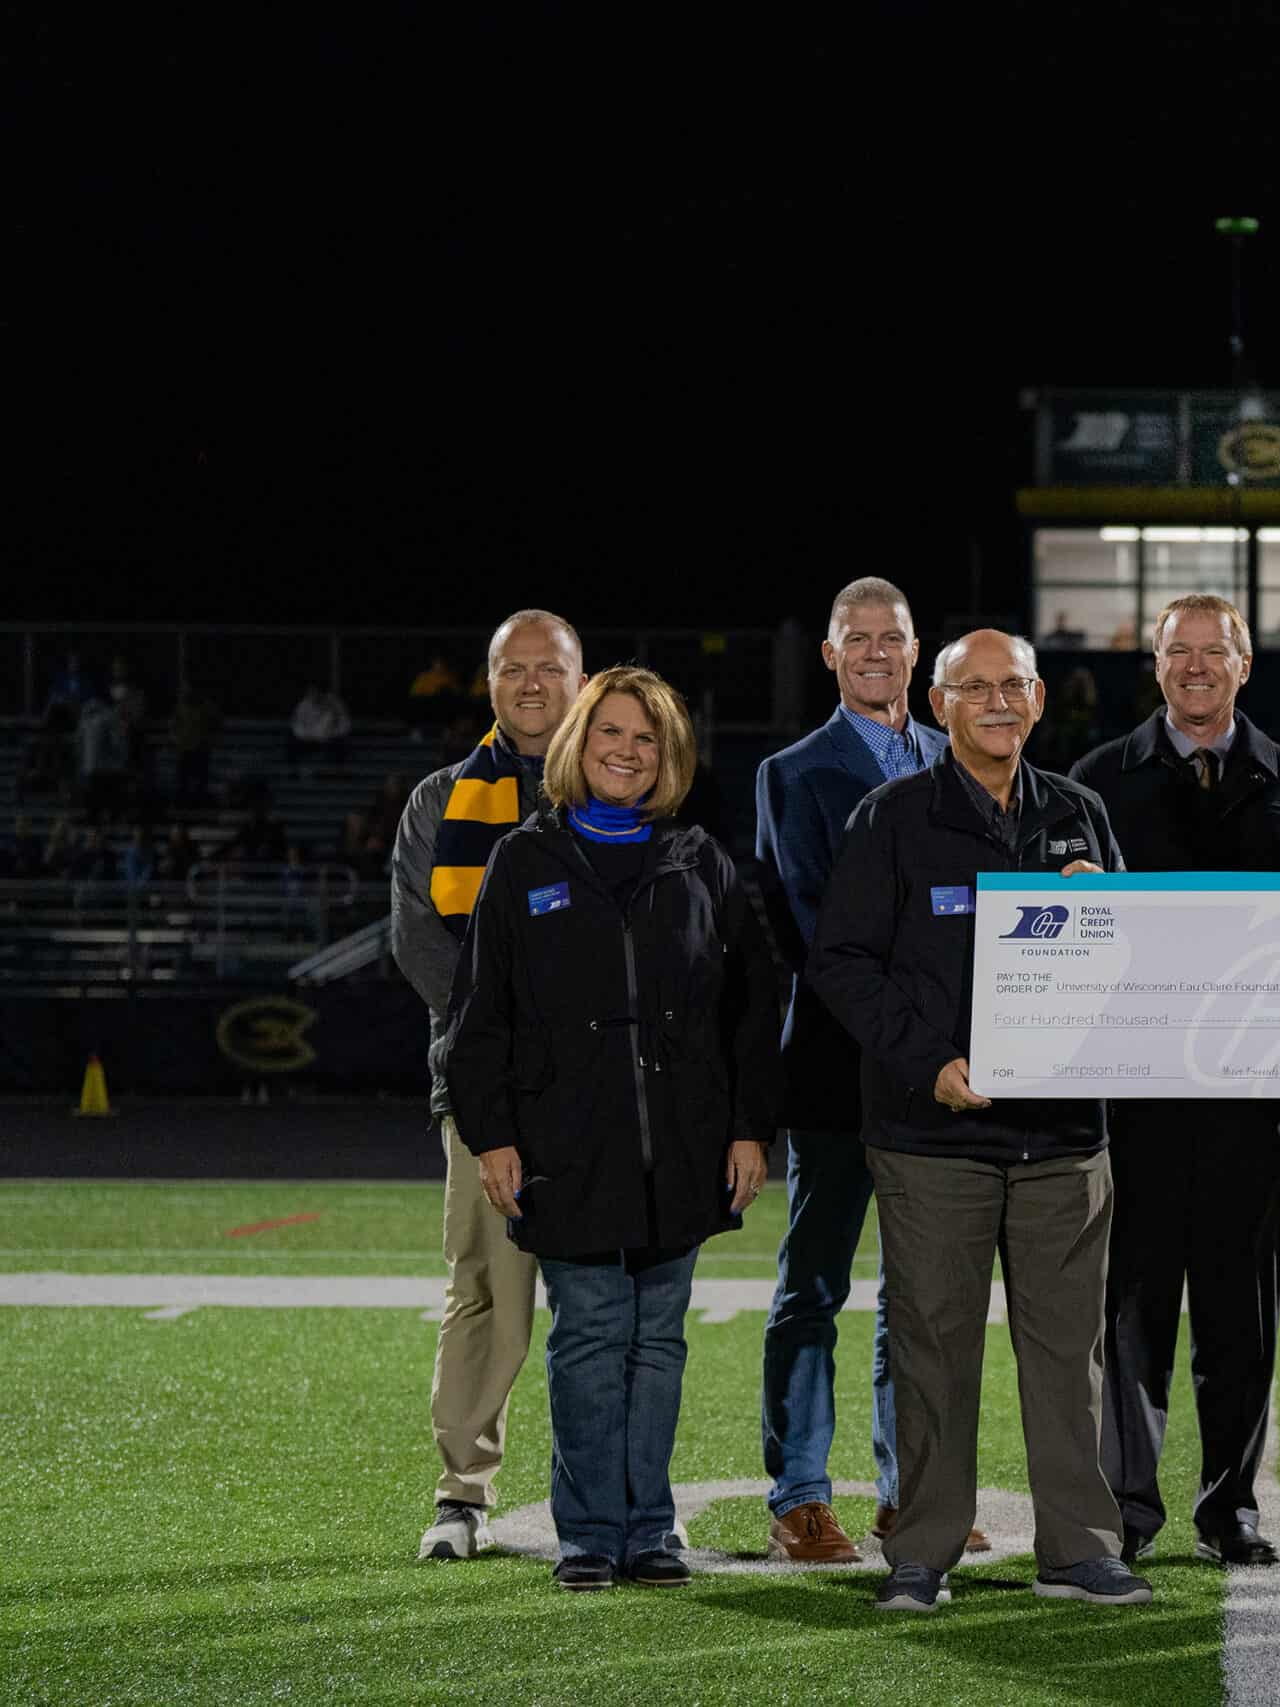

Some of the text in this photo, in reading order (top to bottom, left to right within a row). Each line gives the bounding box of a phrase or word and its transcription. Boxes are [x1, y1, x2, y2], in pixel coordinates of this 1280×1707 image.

[1080, 905, 1113, 916] ROYAL
[1080, 918, 1115, 928] CREDIT
[1080, 929, 1114, 939] UNION
[1021, 948, 1090, 957] FOUNDATION
[996, 973, 1053, 982] PAY TO THE
[996, 984, 1049, 994] ORDER OF
[1056, 981, 1107, 994] University
[1110, 981, 1121, 992] of
[1123, 981, 1177, 993] Wisconsin
[1179, 981, 1200, 993] Eau
[1202, 981, 1233, 993] Claire
[994, 1013, 1026, 1026] Four
[1031, 1013, 1094, 1026] Hundred
[1098, 1013, 1168, 1026] Thousand
[992, 1063, 1151, 1079] FOR Simpson Field
